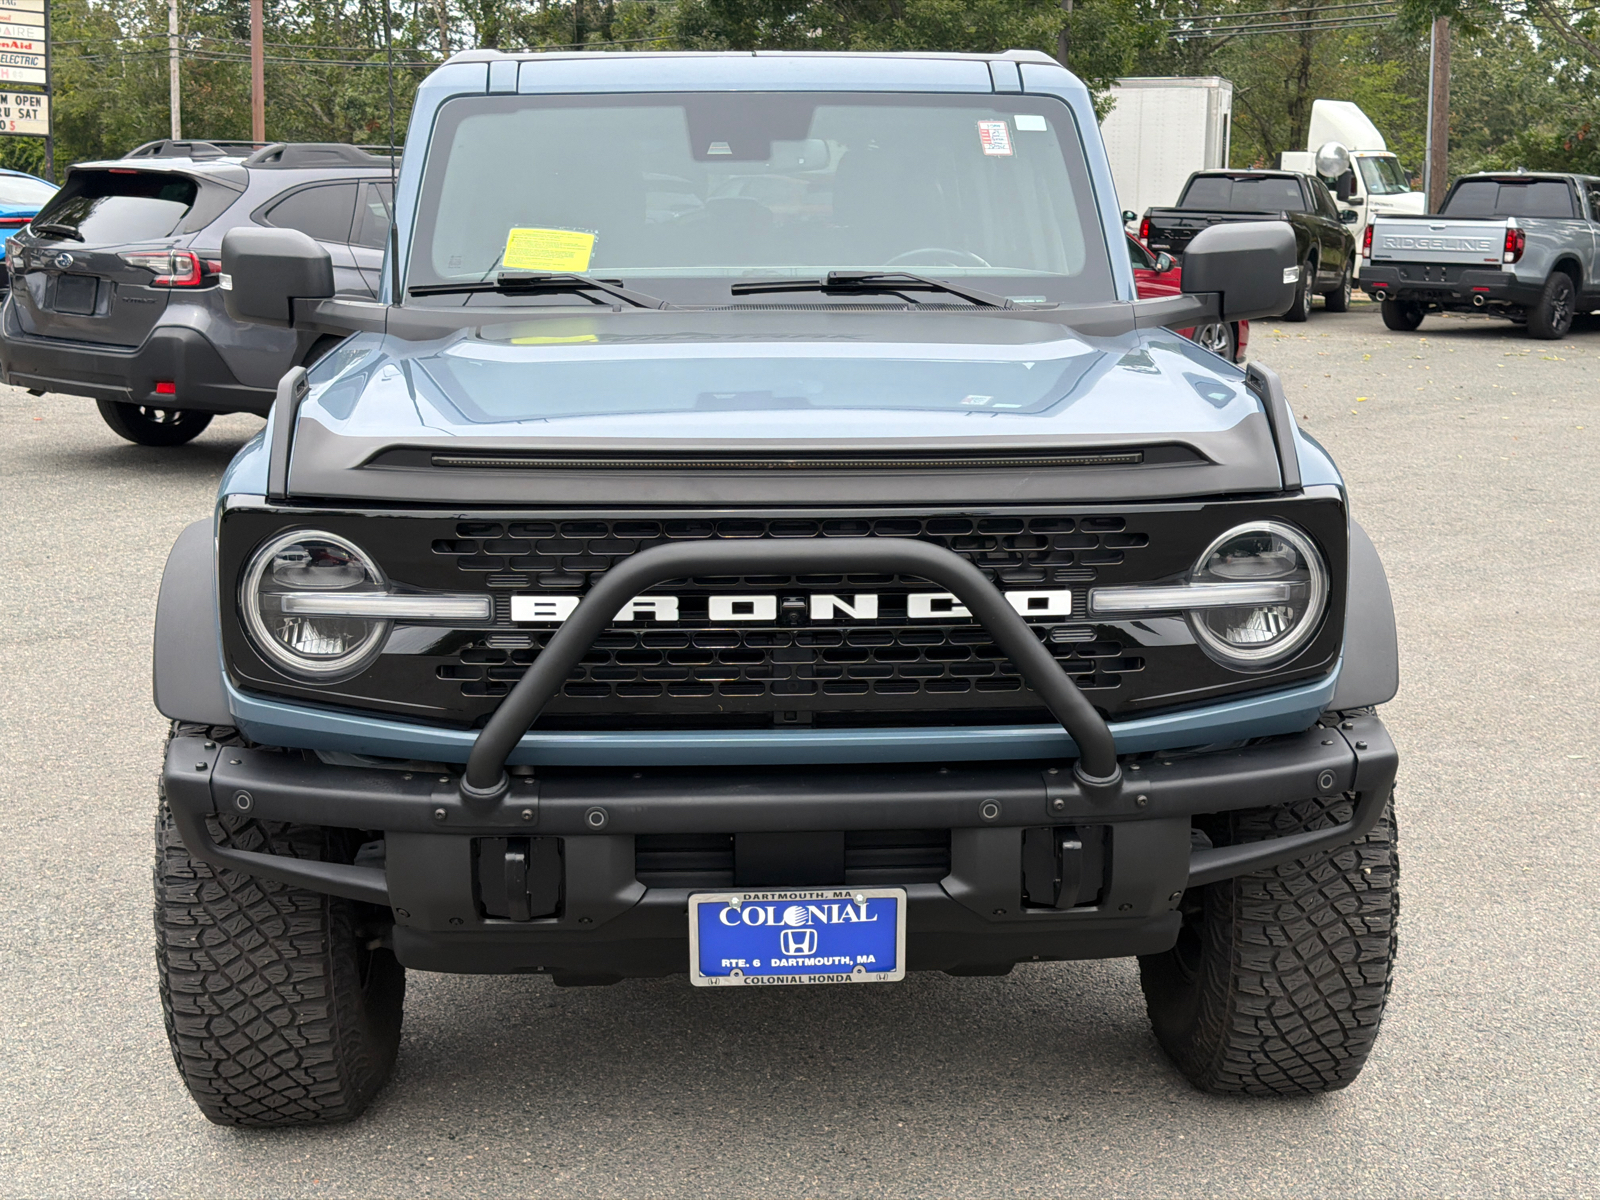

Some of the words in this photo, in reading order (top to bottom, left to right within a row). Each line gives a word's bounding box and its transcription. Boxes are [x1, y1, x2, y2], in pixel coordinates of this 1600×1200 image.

[0, 26, 34, 38] AIRE
[1, 54, 39, 66] ELECTRIC
[15, 95, 41, 107] OPEN
[18, 108, 38, 119] SAT
[1382, 237, 1491, 252] RIDGELINE
[719, 903, 878, 927] COLONIAL
[721, 959, 750, 968] RTE.
[752, 959, 761, 967] 6
[771, 956, 854, 968] DARTMOUTH,
[856, 955, 876, 964] MA
[743, 975, 805, 985] COLONIAL
[808, 974, 853, 983] HONDA
